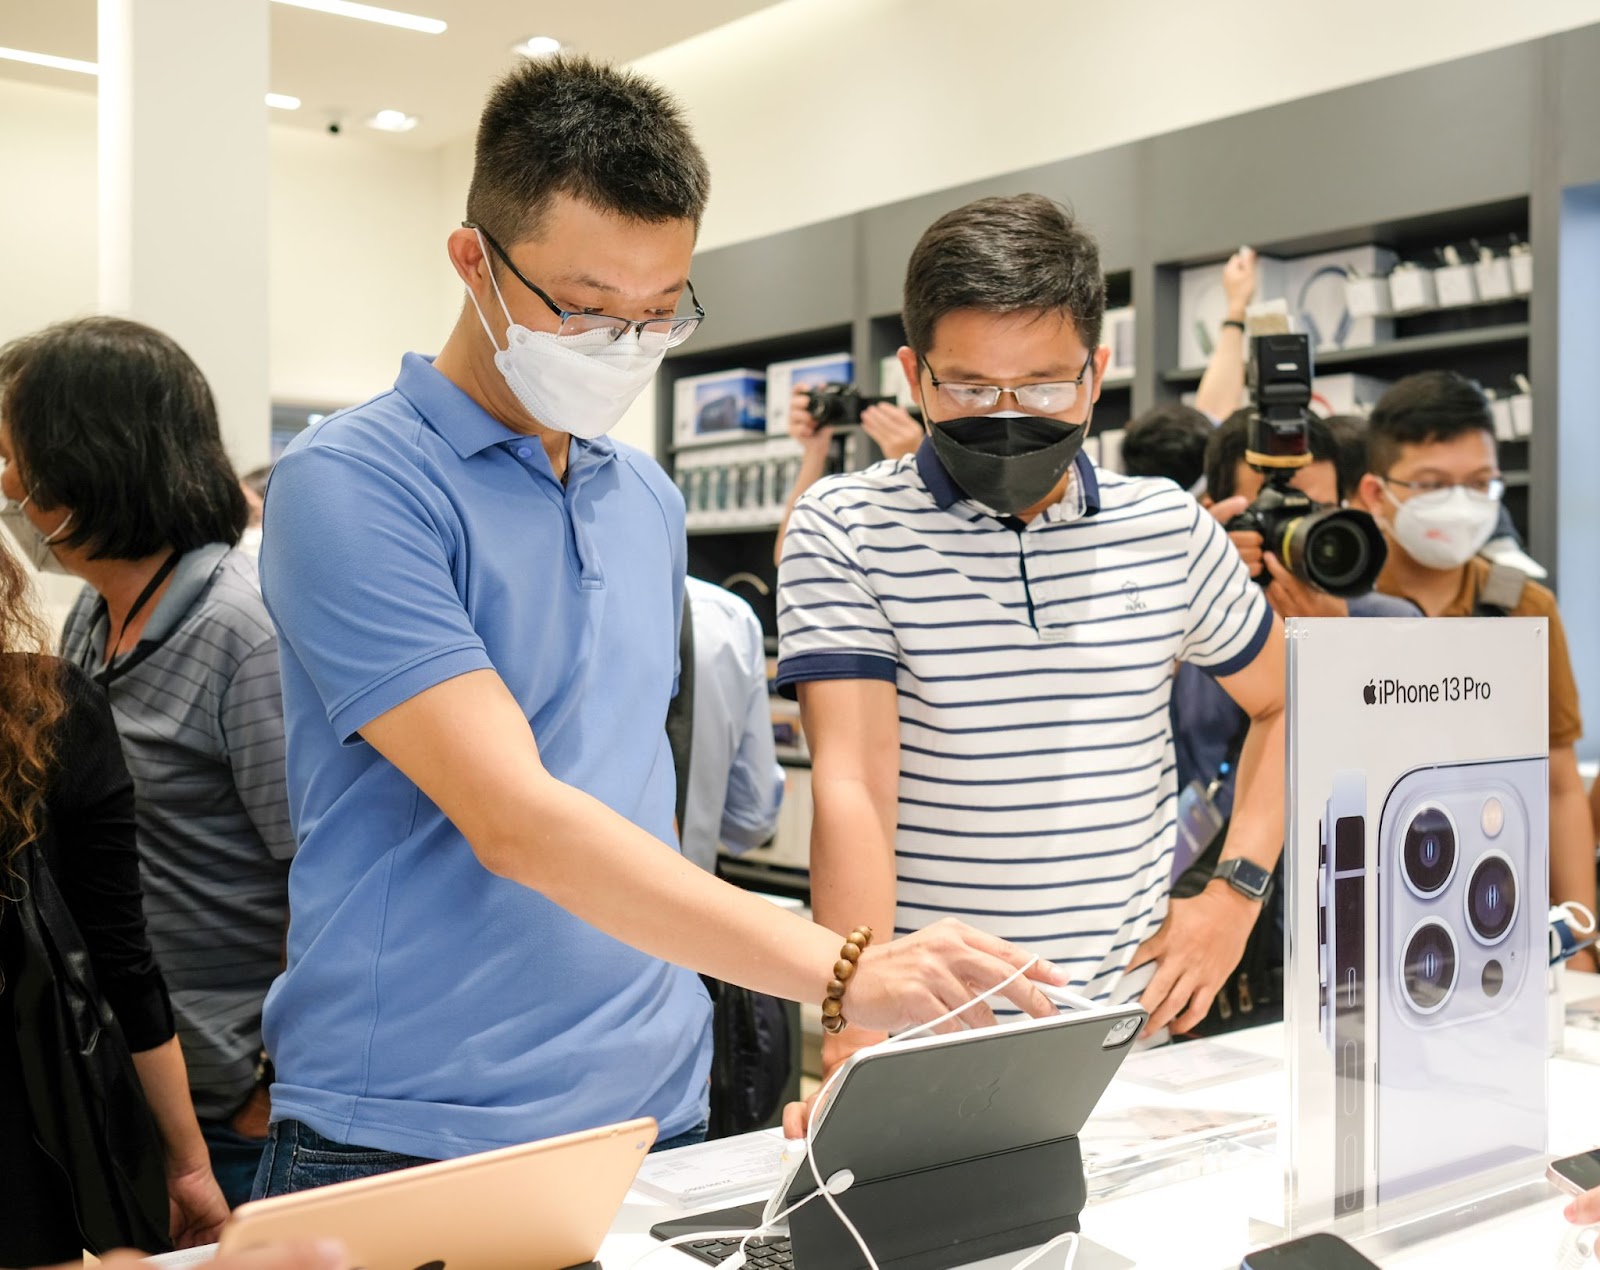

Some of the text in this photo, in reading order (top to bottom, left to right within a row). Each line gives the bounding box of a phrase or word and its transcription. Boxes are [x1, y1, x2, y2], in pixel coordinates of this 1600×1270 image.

[1379, 677, 1491, 704] iPhone 13 Pro
